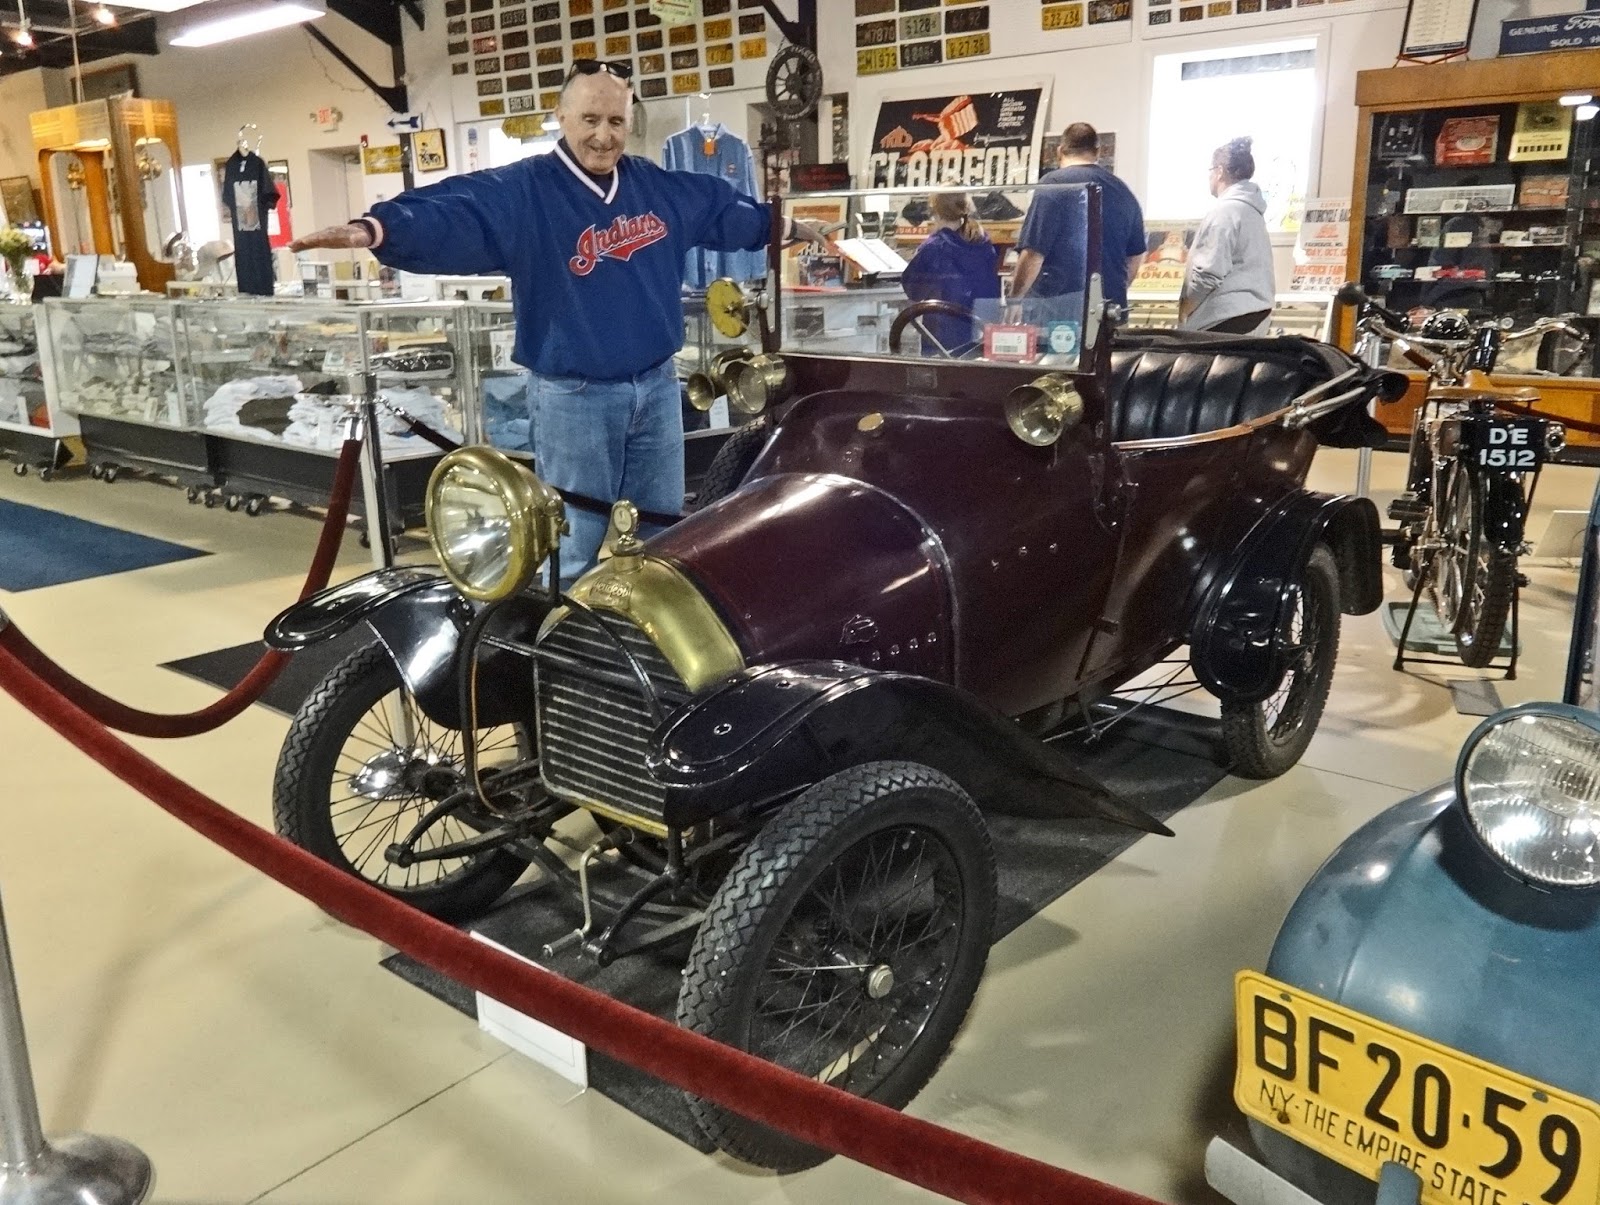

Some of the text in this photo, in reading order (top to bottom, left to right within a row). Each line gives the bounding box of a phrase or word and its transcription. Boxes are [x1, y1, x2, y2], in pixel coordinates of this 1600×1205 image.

[1508, 15, 1600, 37] GENUINE For
[1550, 37, 1583, 48] SOLD
[569, 211, 667, 276] Indians
[1489, 428, 1529, 445] DE
[1479, 449, 1536, 467] 1512
[1345, 1122, 1426, 1173] EMPIRE
[1431, 1161, 1507, 1205] STATE
